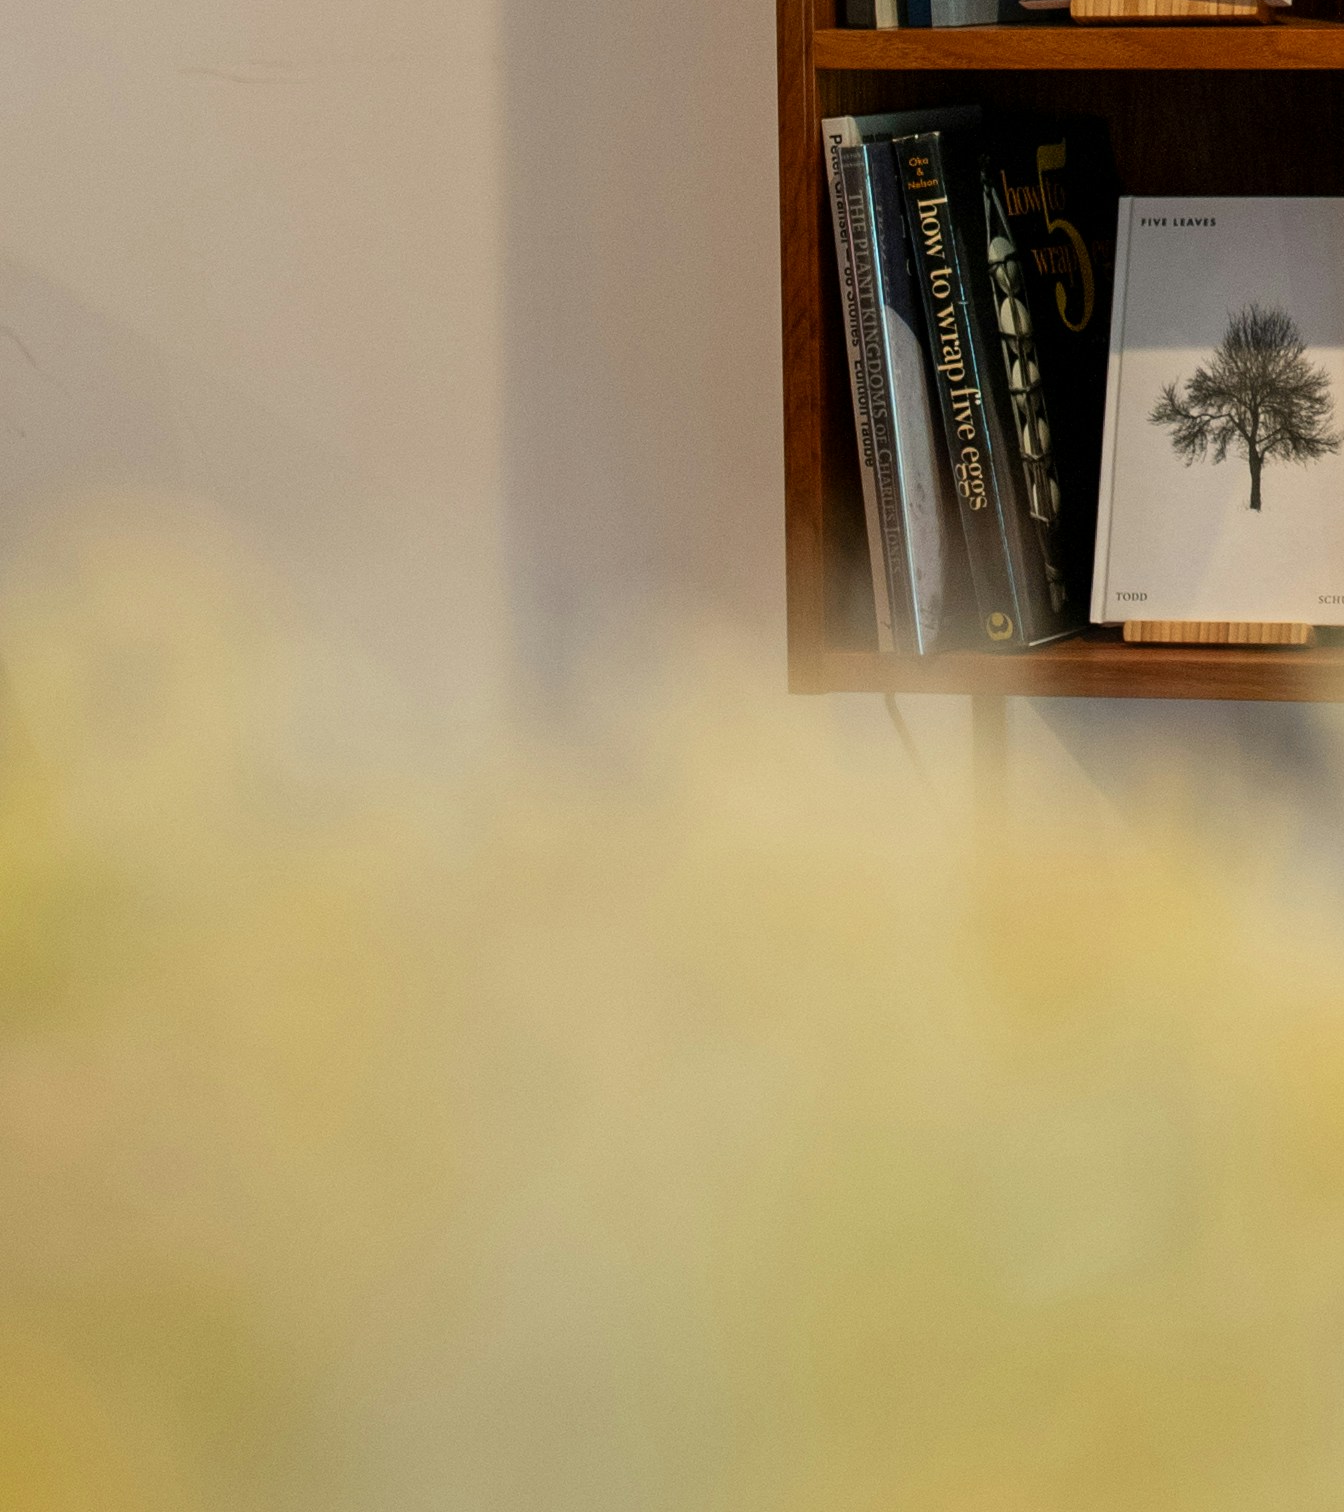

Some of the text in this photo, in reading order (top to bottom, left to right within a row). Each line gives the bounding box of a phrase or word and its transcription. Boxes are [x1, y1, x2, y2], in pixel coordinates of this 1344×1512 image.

[908, 157, 929, 168] Oka
[916, 169, 925, 177] &
[907, 178, 939, 190] Nelson
[849, 189, 865, 231] THE
[1140, 217, 1217, 227] FIVE LEAVES
[855, 235, 874, 307] PLANT
[917, 194, 988, 512] how to wrap five eggs
[861, 307, 888, 420] KINGDOMS
[1116, 592, 1148, 602] TODD
